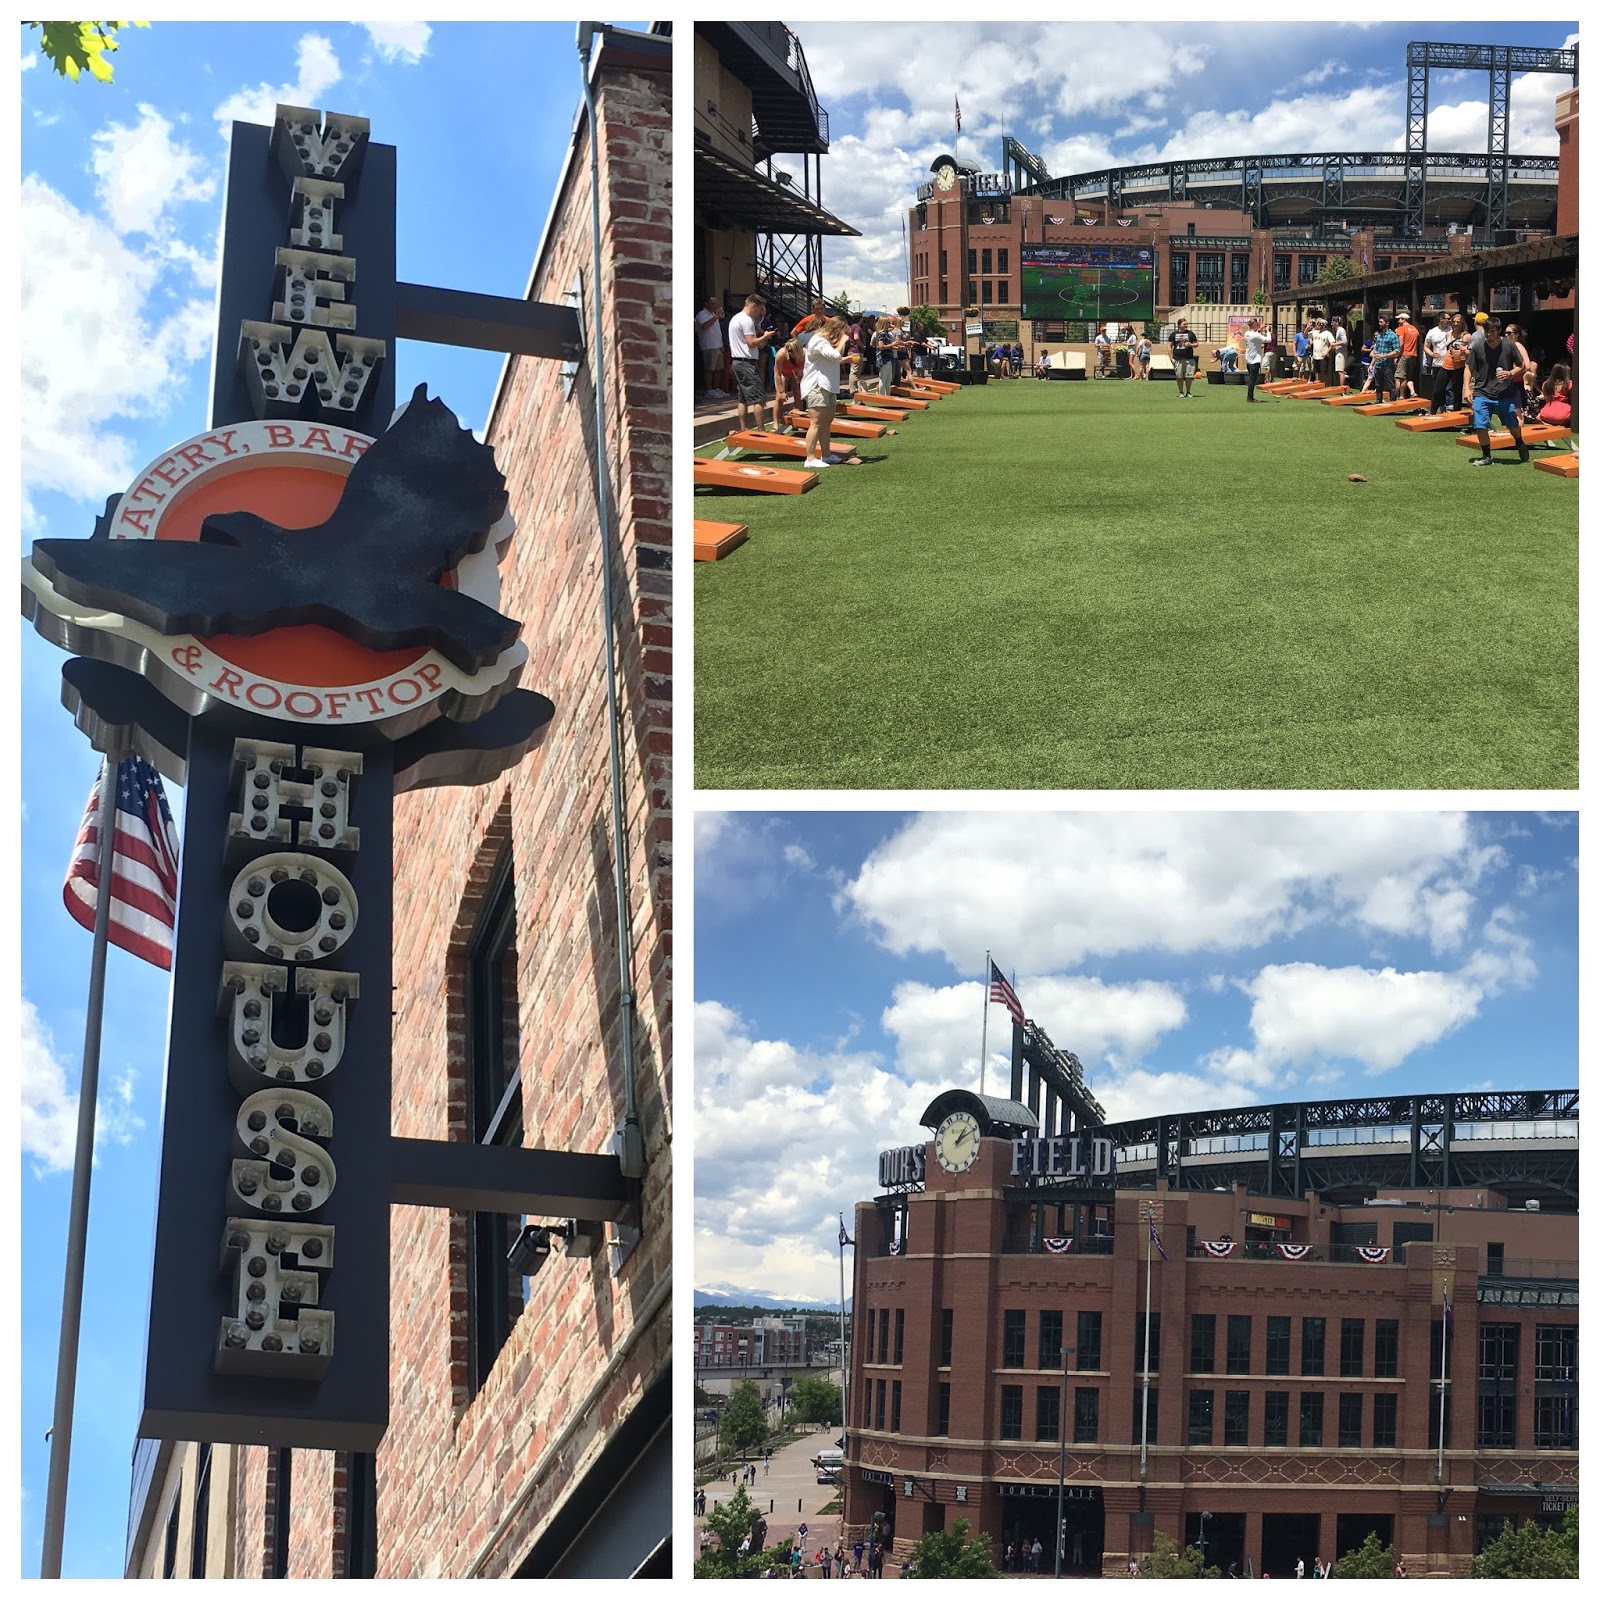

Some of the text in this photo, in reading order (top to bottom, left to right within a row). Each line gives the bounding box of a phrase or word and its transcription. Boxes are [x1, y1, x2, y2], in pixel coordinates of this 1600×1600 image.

[967, 173, 1011, 192] FIELD
[239, 103, 386, 413] VIEW
[116, 424, 373, 540] ATERY, BAR
[171, 645, 443, 719] & ROOFTOP
[215, 737, 363, 1378] HOUSE
[1010, 1137, 1115, 1177] FIELD
[999, 1486, 1094, 1498] HOME PATE
[1541, 1501, 1565, 1512] TICKET
